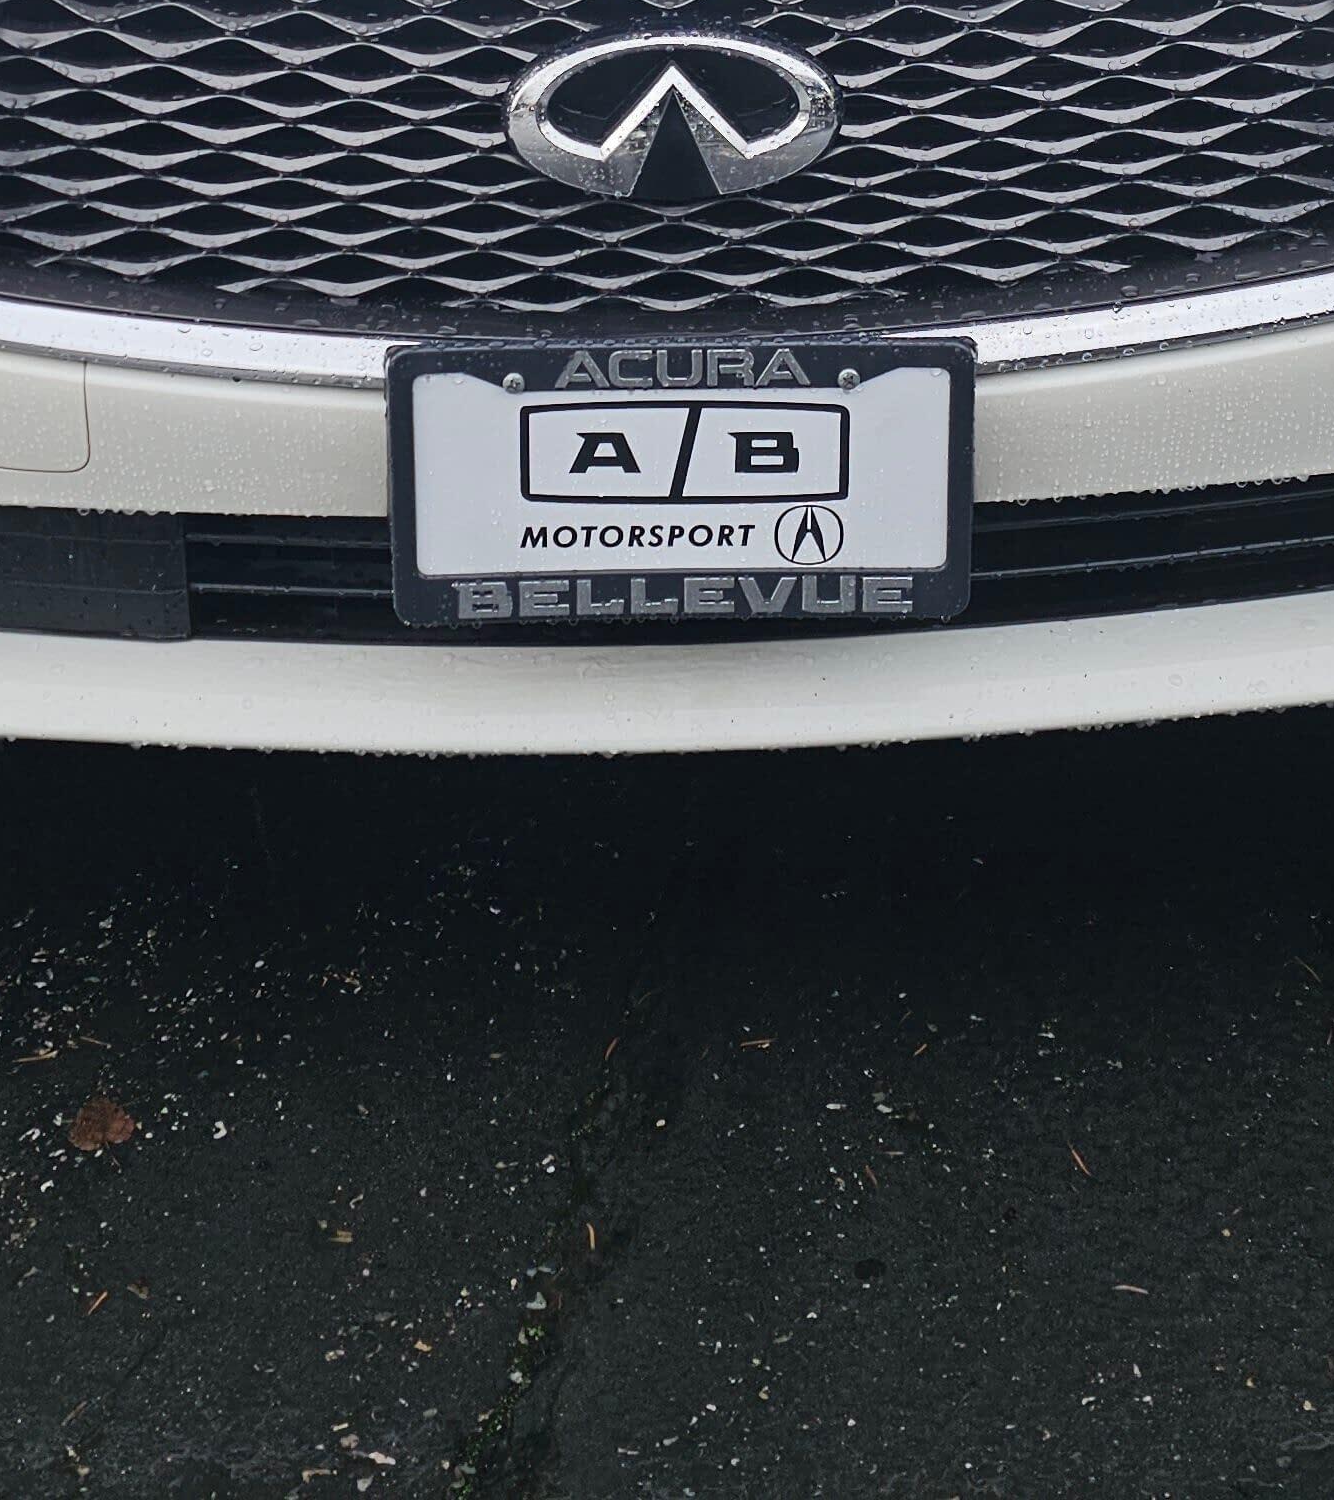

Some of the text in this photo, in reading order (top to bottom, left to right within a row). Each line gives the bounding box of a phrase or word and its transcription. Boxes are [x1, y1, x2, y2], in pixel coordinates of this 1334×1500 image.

[554, 347, 811, 390] ACURA
[520, 523, 756, 549] MOTORSPORT
[450, 575, 915, 619] BELLEVUE
